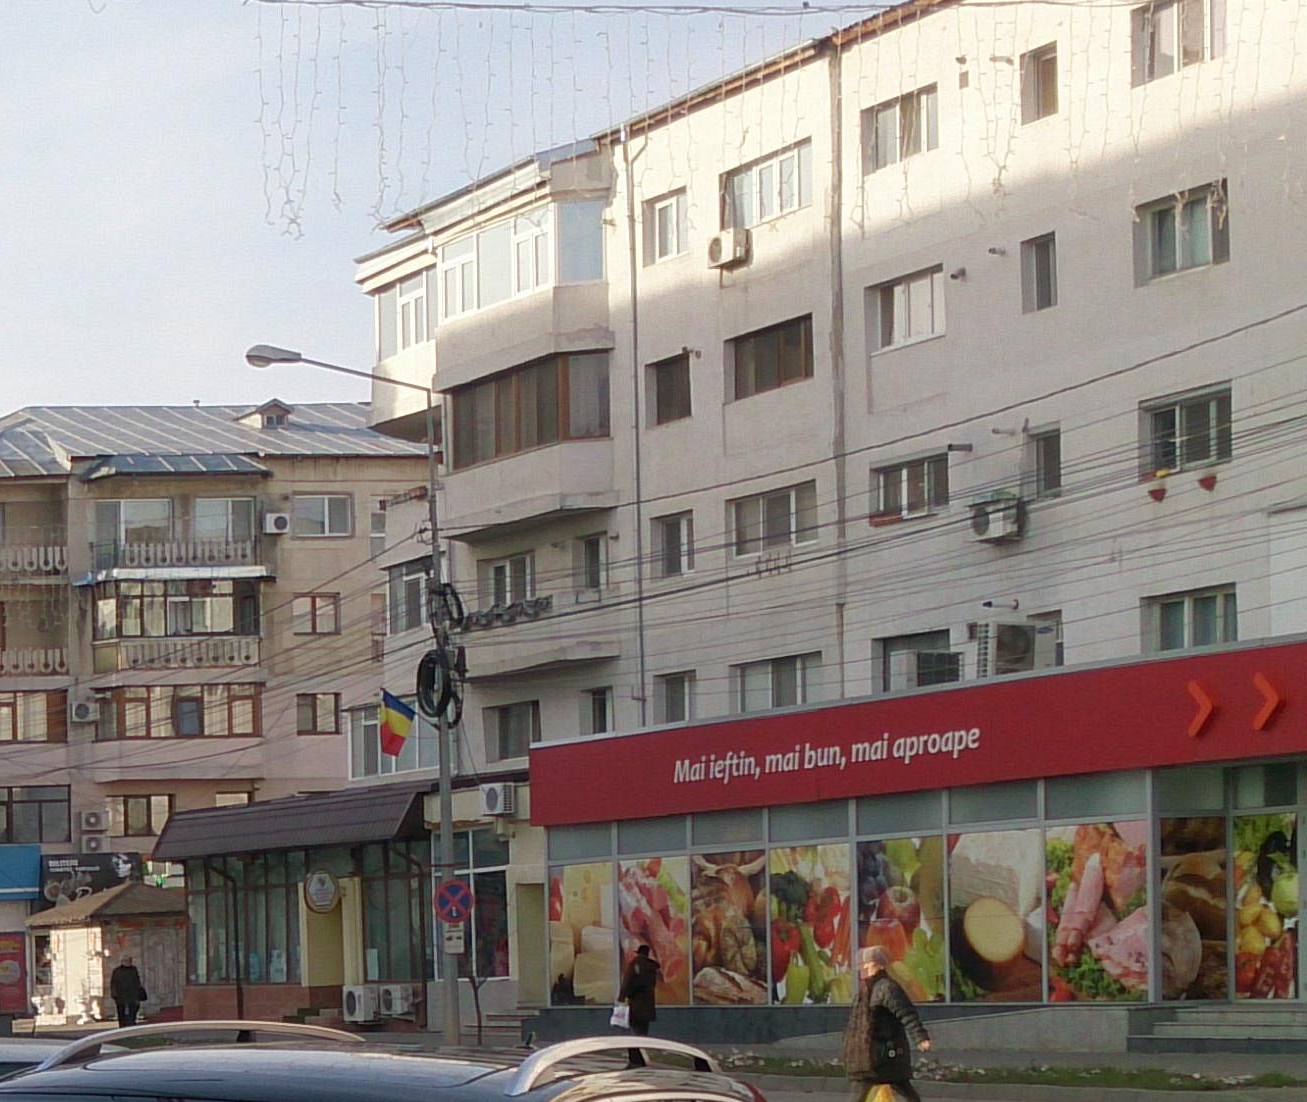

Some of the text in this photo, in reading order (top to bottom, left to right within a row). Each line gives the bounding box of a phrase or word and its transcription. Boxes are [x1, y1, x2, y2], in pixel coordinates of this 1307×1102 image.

[673, 727, 981, 785] Mai ieftin, mai bun, mai aproape
